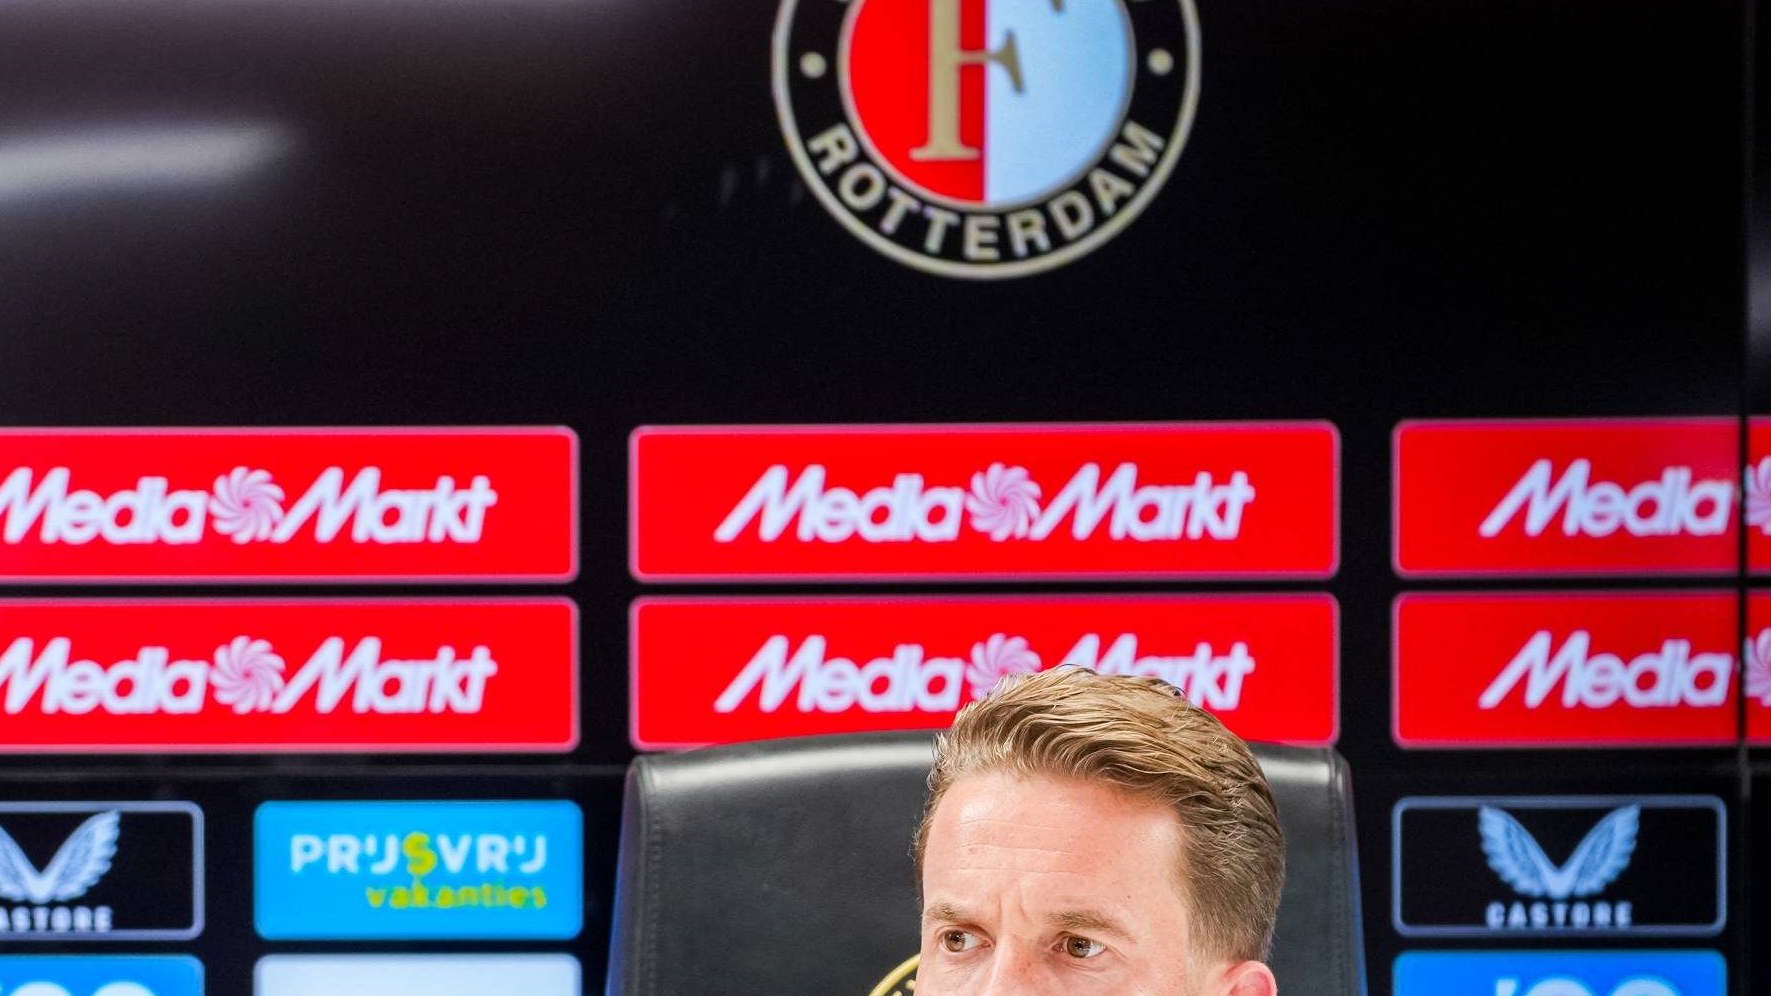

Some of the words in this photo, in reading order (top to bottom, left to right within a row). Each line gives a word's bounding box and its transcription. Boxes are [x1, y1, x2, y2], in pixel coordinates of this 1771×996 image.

[809, 121, 1165, 260] ROTTERDAM
[271, 466, 497, 543] Markt
[713, 464, 965, 542] Media
[1027, 462, 1255, 541] Markt
[1478, 458, 1733, 537] Media
[271, 636, 498, 714] Markt
[713, 635, 966, 712] Media
[1478, 630, 1733, 709] Media
[365, 882, 547, 909] vakanties
[1485, 901, 1632, 929] CASTORE
